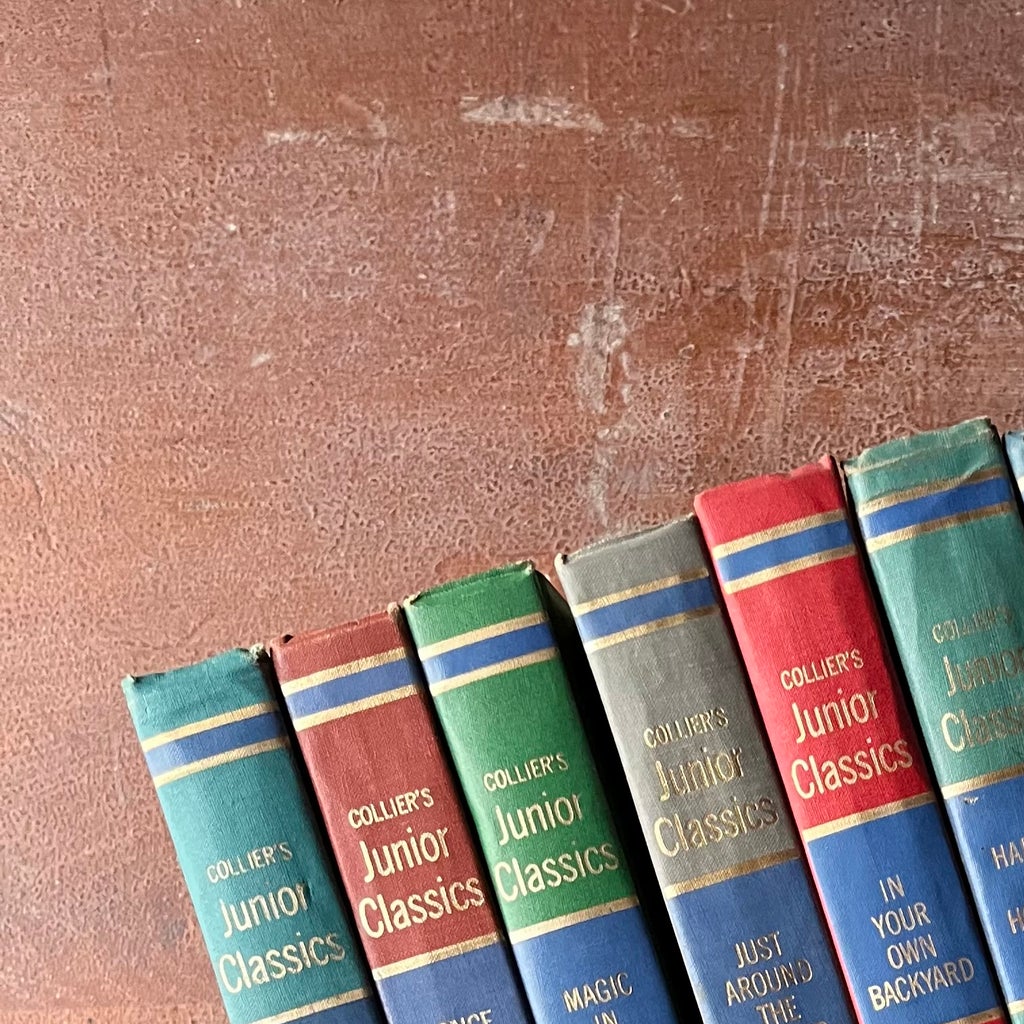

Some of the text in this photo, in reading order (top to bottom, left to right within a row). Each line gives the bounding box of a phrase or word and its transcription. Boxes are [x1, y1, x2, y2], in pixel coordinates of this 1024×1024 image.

[780, 648, 865, 691] COLLIER'S
[644, 707, 730, 749] COLLIER'S
[791, 687, 879, 744] Junior
[483, 752, 570, 793] COLLIER'S
[654, 746, 746, 802] Junior
[790, 737, 914, 801] Classics
[347, 787, 435, 830] COLLIER'S
[494, 791, 583, 847] Junior
[653, 796, 781, 858] Classics
[206, 841, 293, 884] COLLIER'S
[359, 825, 451, 883] Junior
[493, 840, 620, 903] Classics
[222, 878, 310, 938] Junior
[358, 875, 486, 939] Classics
[879, 874, 906, 904] IN
[870, 901, 932, 940] YOUR
[218, 930, 347, 995] Classics
[734, 931, 783, 970] JUST
[886, 933, 938, 971] OWN
[562, 972, 634, 1013] MAGIC
[724, 958, 814, 1007] AROUND
[867, 957, 976, 1012] BACKYARD
